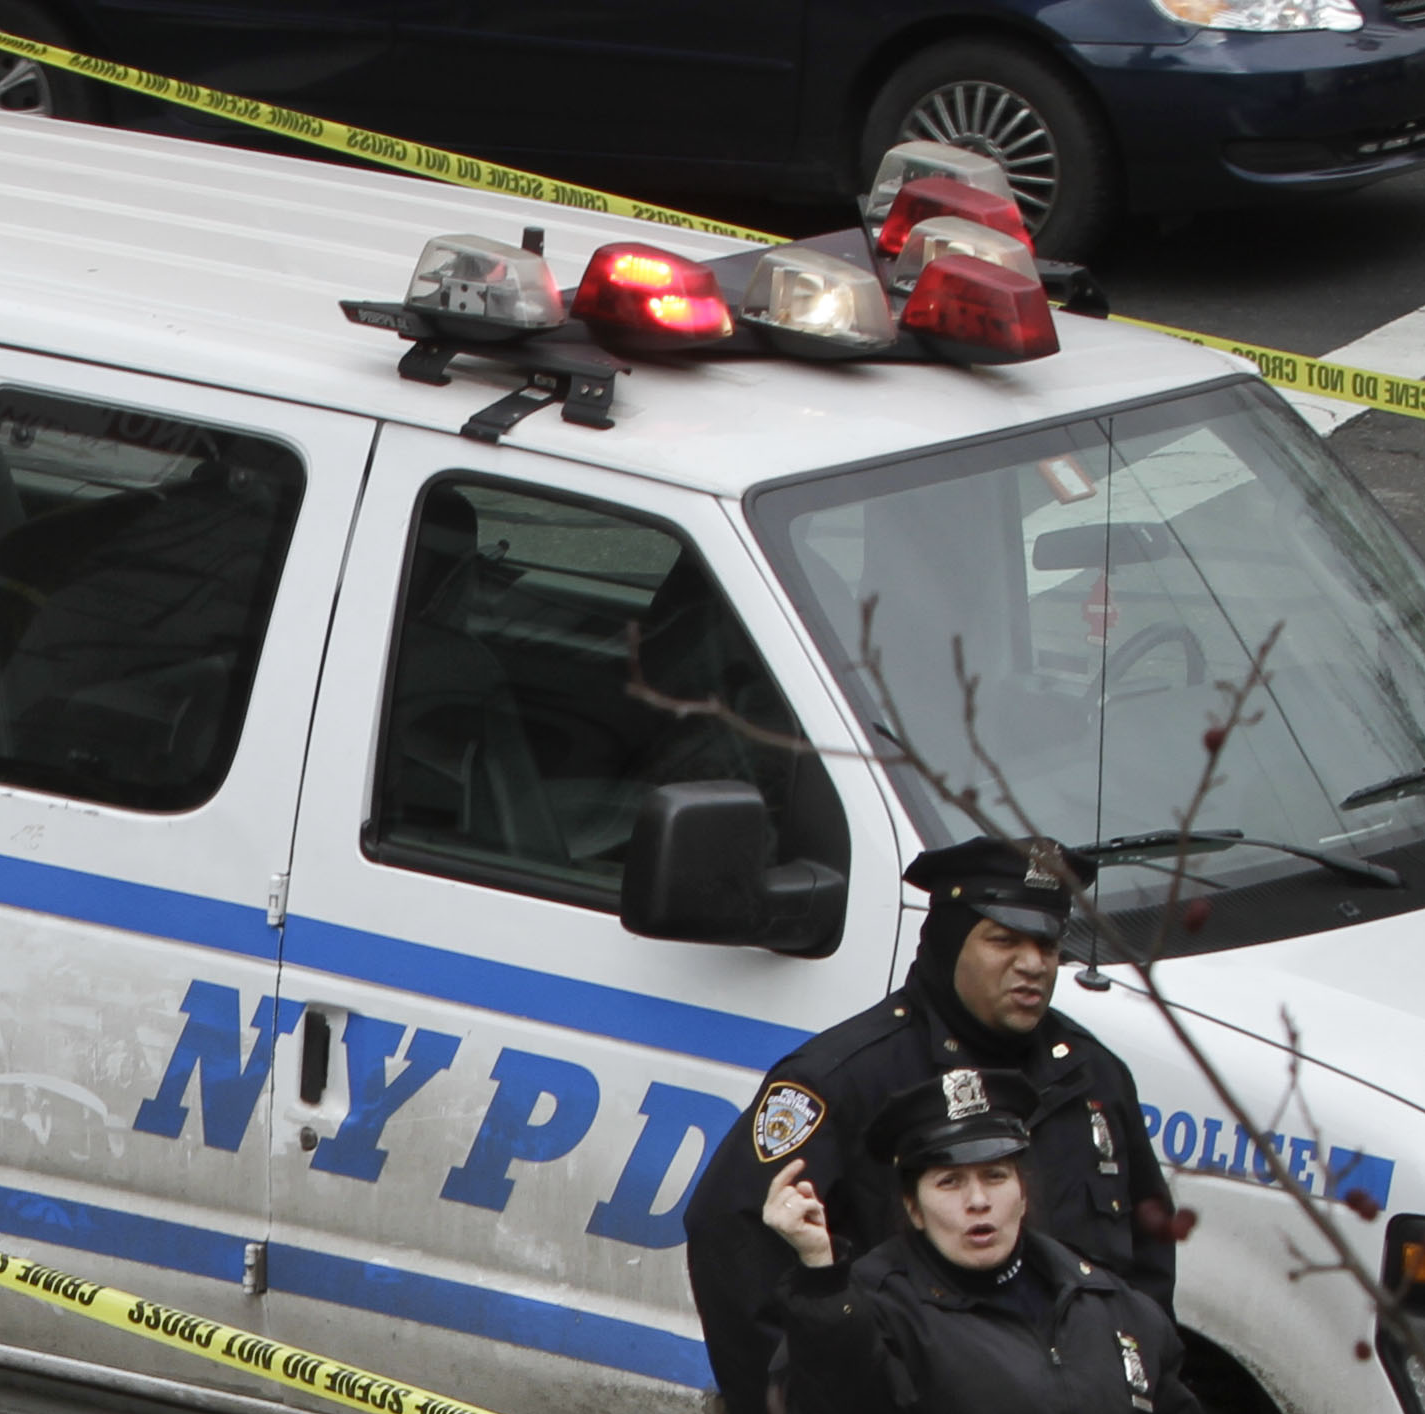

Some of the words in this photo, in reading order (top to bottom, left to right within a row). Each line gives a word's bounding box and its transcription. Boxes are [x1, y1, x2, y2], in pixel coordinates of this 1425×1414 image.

[132, 978, 750, 1250] NYPD
[1139, 1102, 1319, 1194] POLICE
[15, 1259, 104, 1306] CRIME
[127, 1299, 222, 1349] CROSS
[221, 1332, 277, 1370] NOT
[282, 1352, 326, 1385] DO
